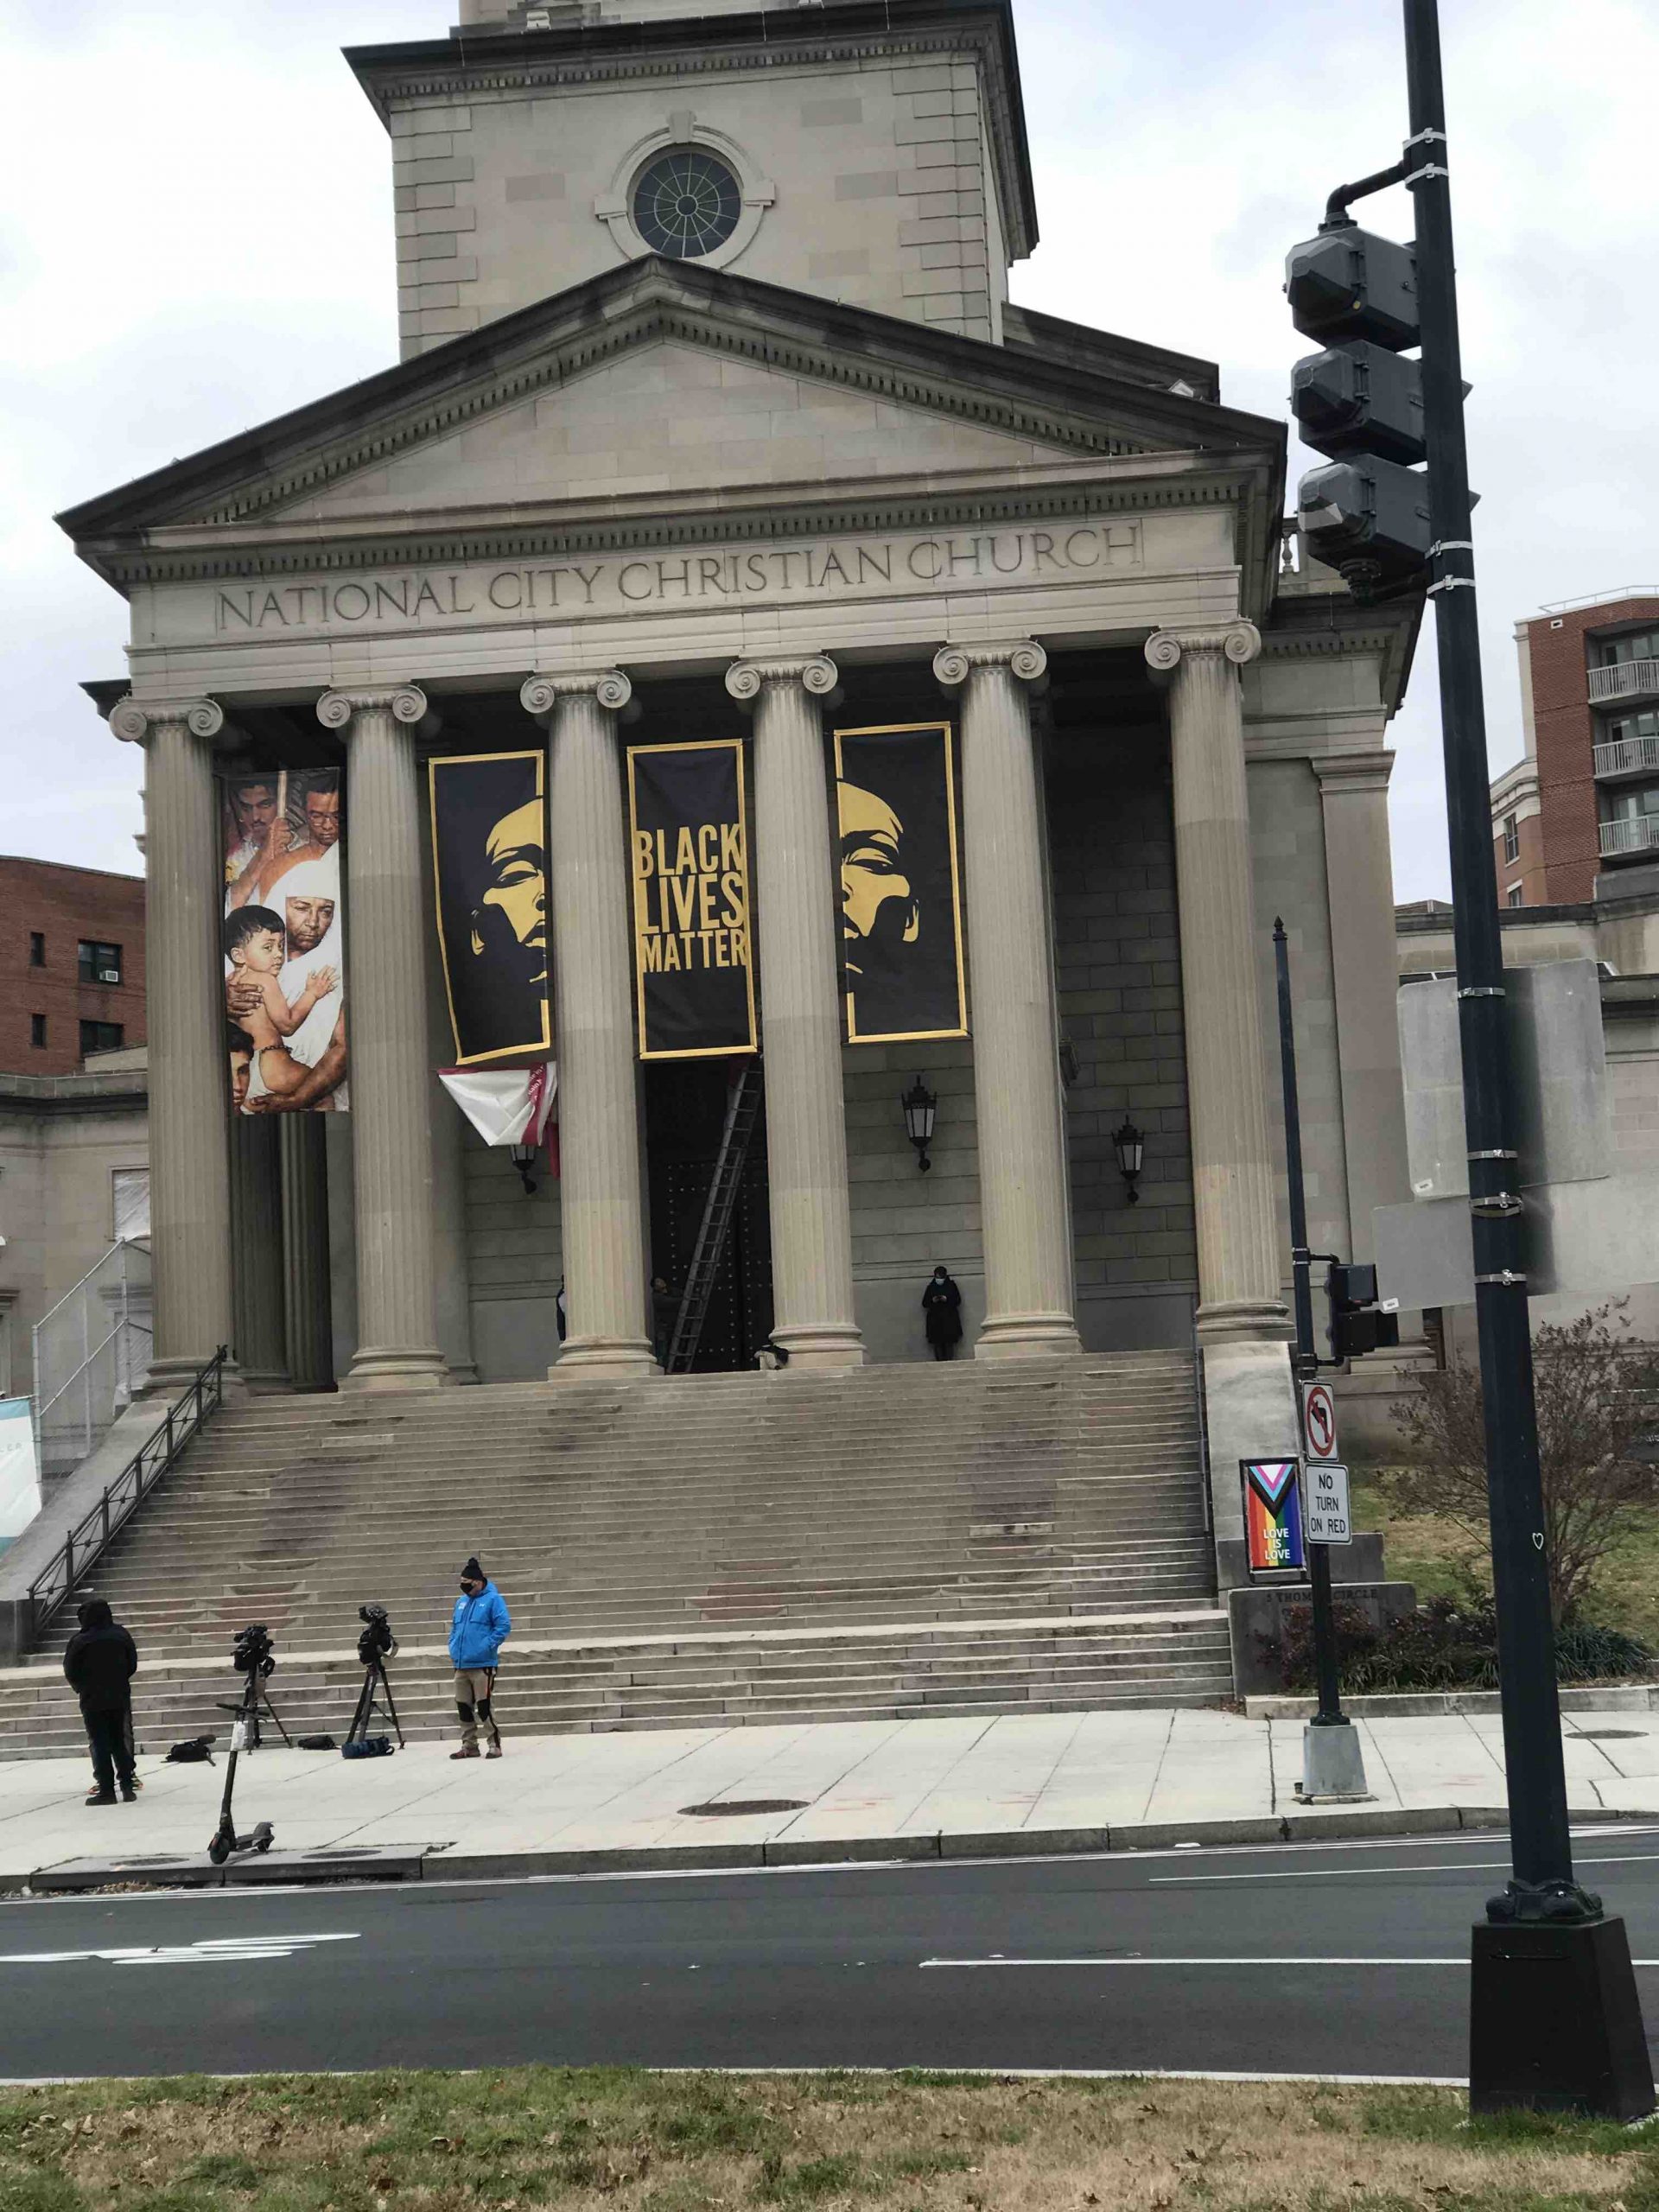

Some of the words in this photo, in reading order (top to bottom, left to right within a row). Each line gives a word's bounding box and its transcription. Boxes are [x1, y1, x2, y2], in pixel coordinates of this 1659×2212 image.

[219, 575, 475, 630] NATIONAL
[488, 565, 603, 609] CITY
[618, 544, 892, 601] CHRISTIAN
[907, 525, 1141, 581] CHURCH
[634, 823, 742, 879] BLACK
[636, 871, 745, 934] LIVES
[639, 929, 748, 973] MATTER
[1319, 1473, 1333, 1490] NO
[1315, 1496, 1339, 1511] TURN
[1263, 1528, 1289, 1539] LOVE
[1311, 1517, 1323, 1533] ON
[1327, 1518, 1346, 1534] RED
[1273, 1538, 1281, 1548] IS
[1264, 1548, 1291, 1560] LOVE
[1275, 1592, 1313, 1603] THOM
